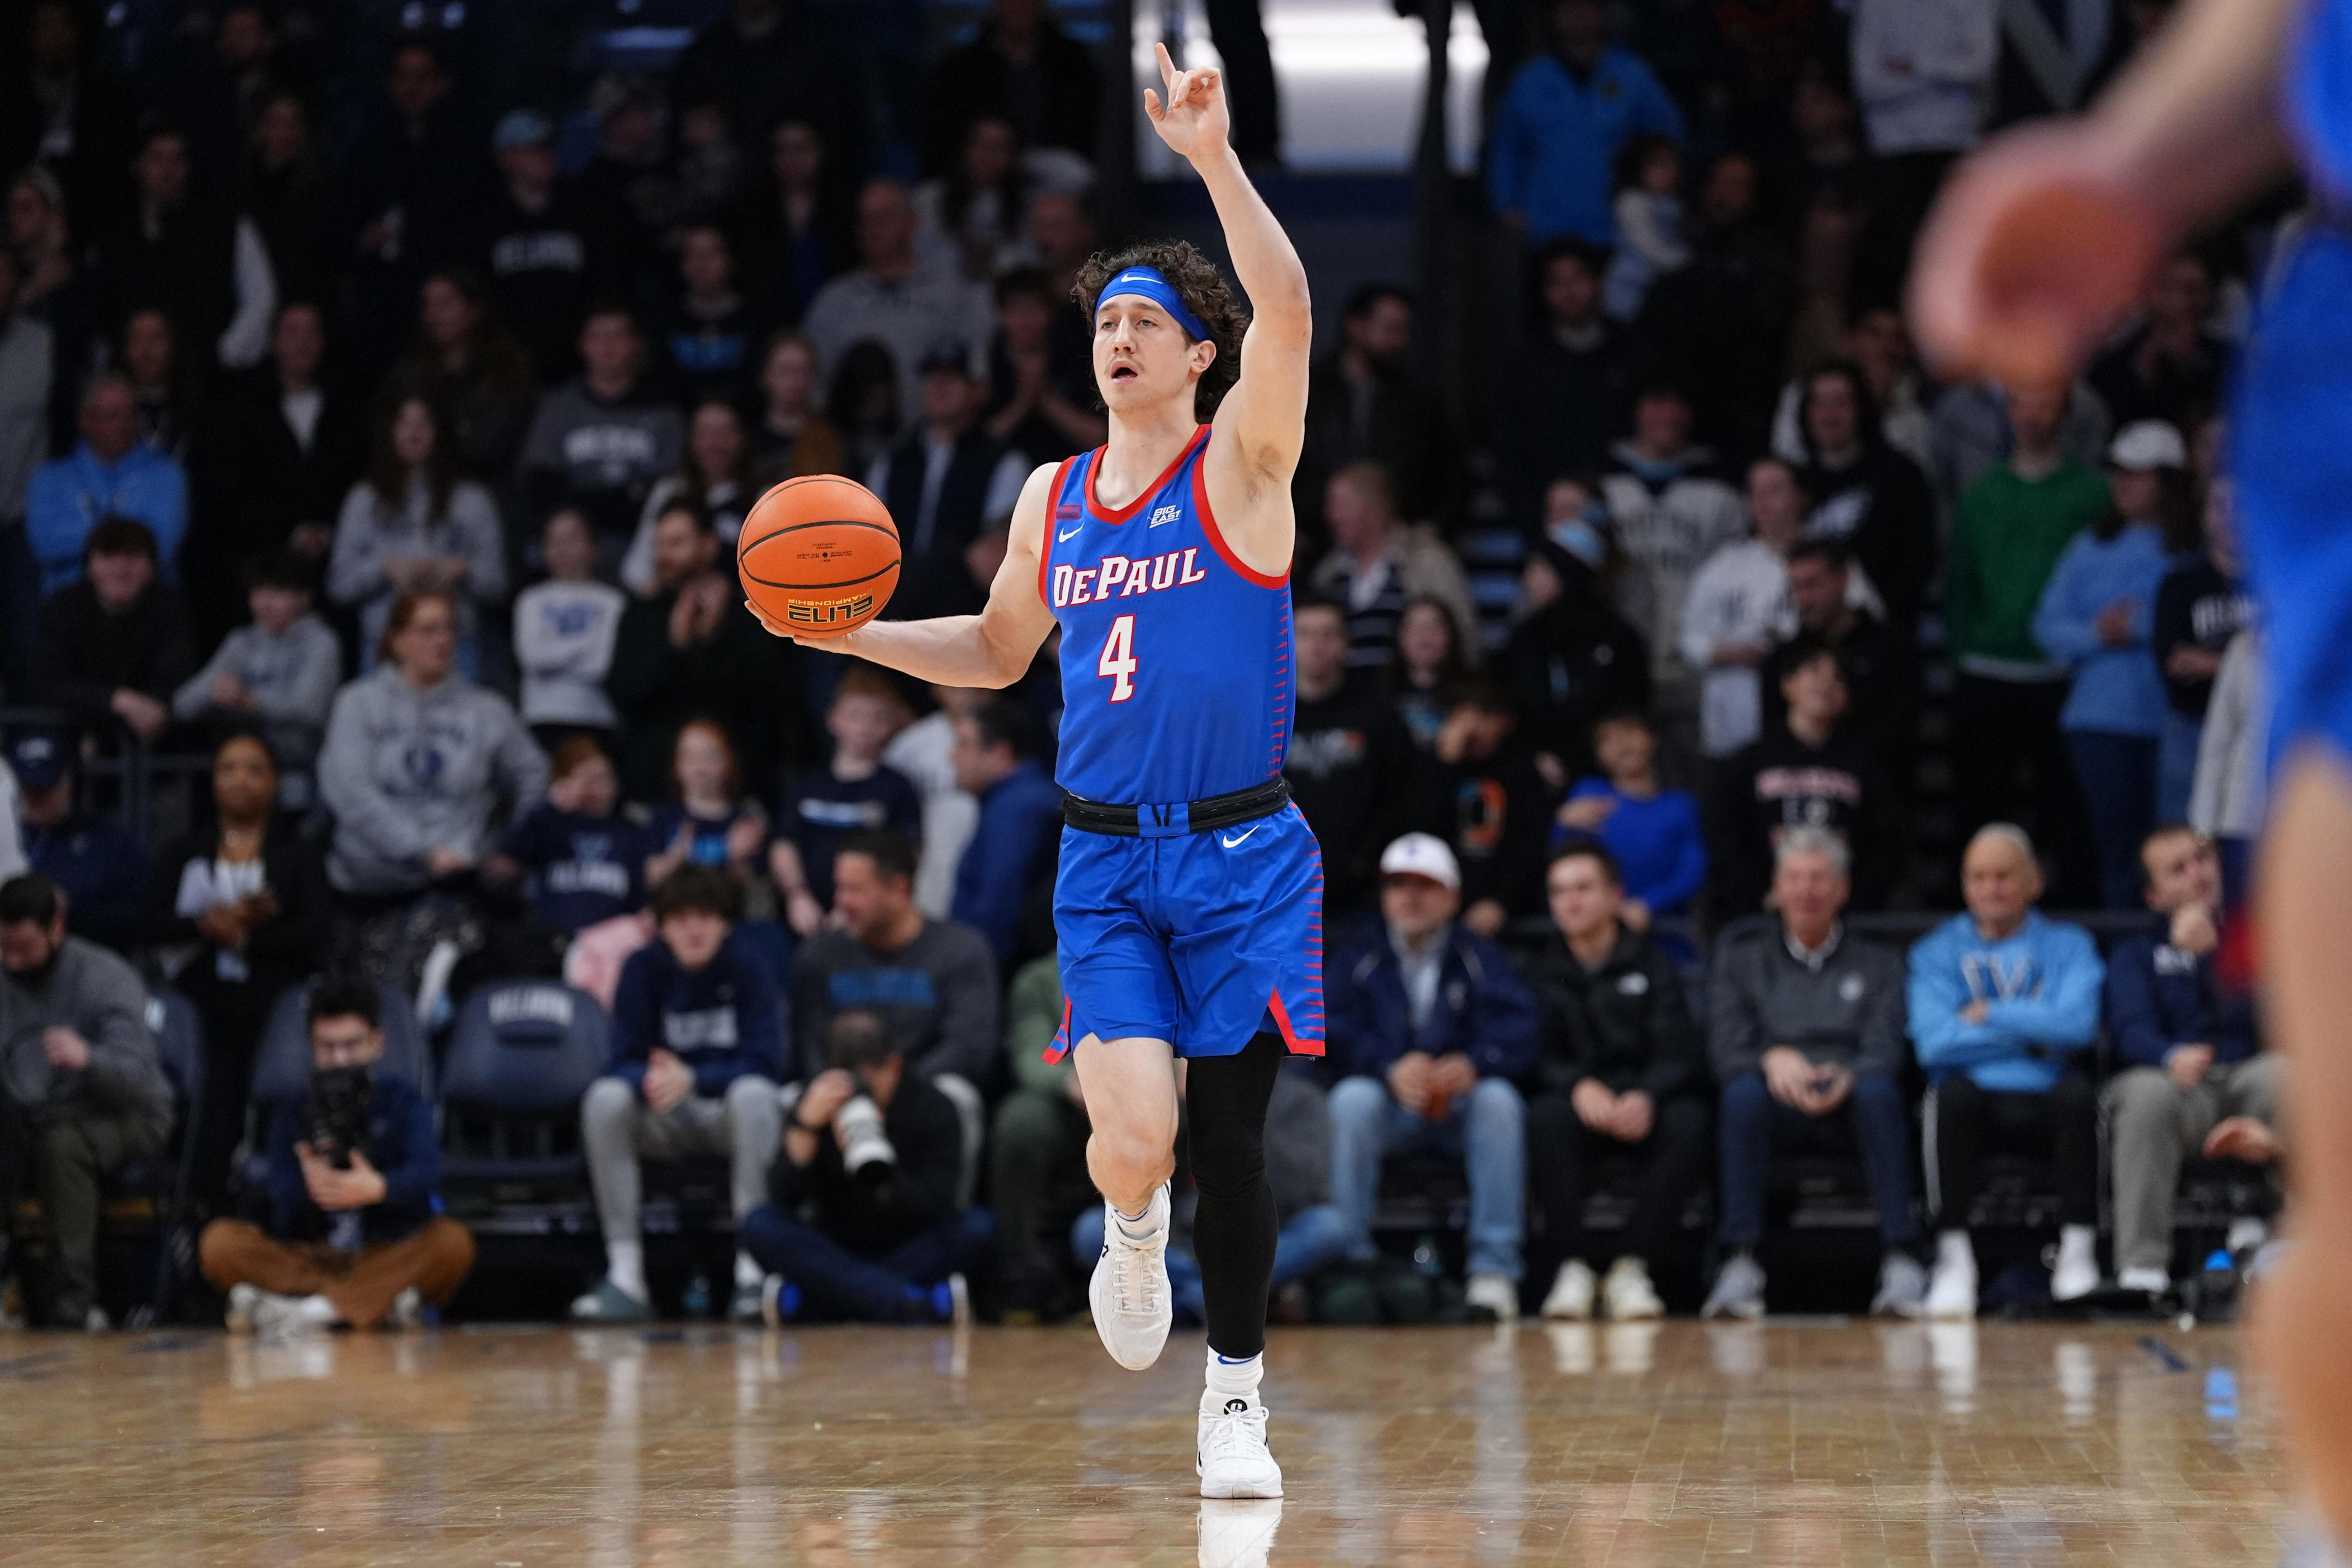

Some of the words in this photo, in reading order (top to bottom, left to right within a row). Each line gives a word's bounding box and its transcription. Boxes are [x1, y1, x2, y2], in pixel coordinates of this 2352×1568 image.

[1151, 510, 1181, 524] EAST
[1153, 505, 1176, 517] BIG
[788, 589, 872, 606] CHAMPIONSHIP
[788, 595, 873, 623] ELITE
[1098, 614, 1138, 703] 4
